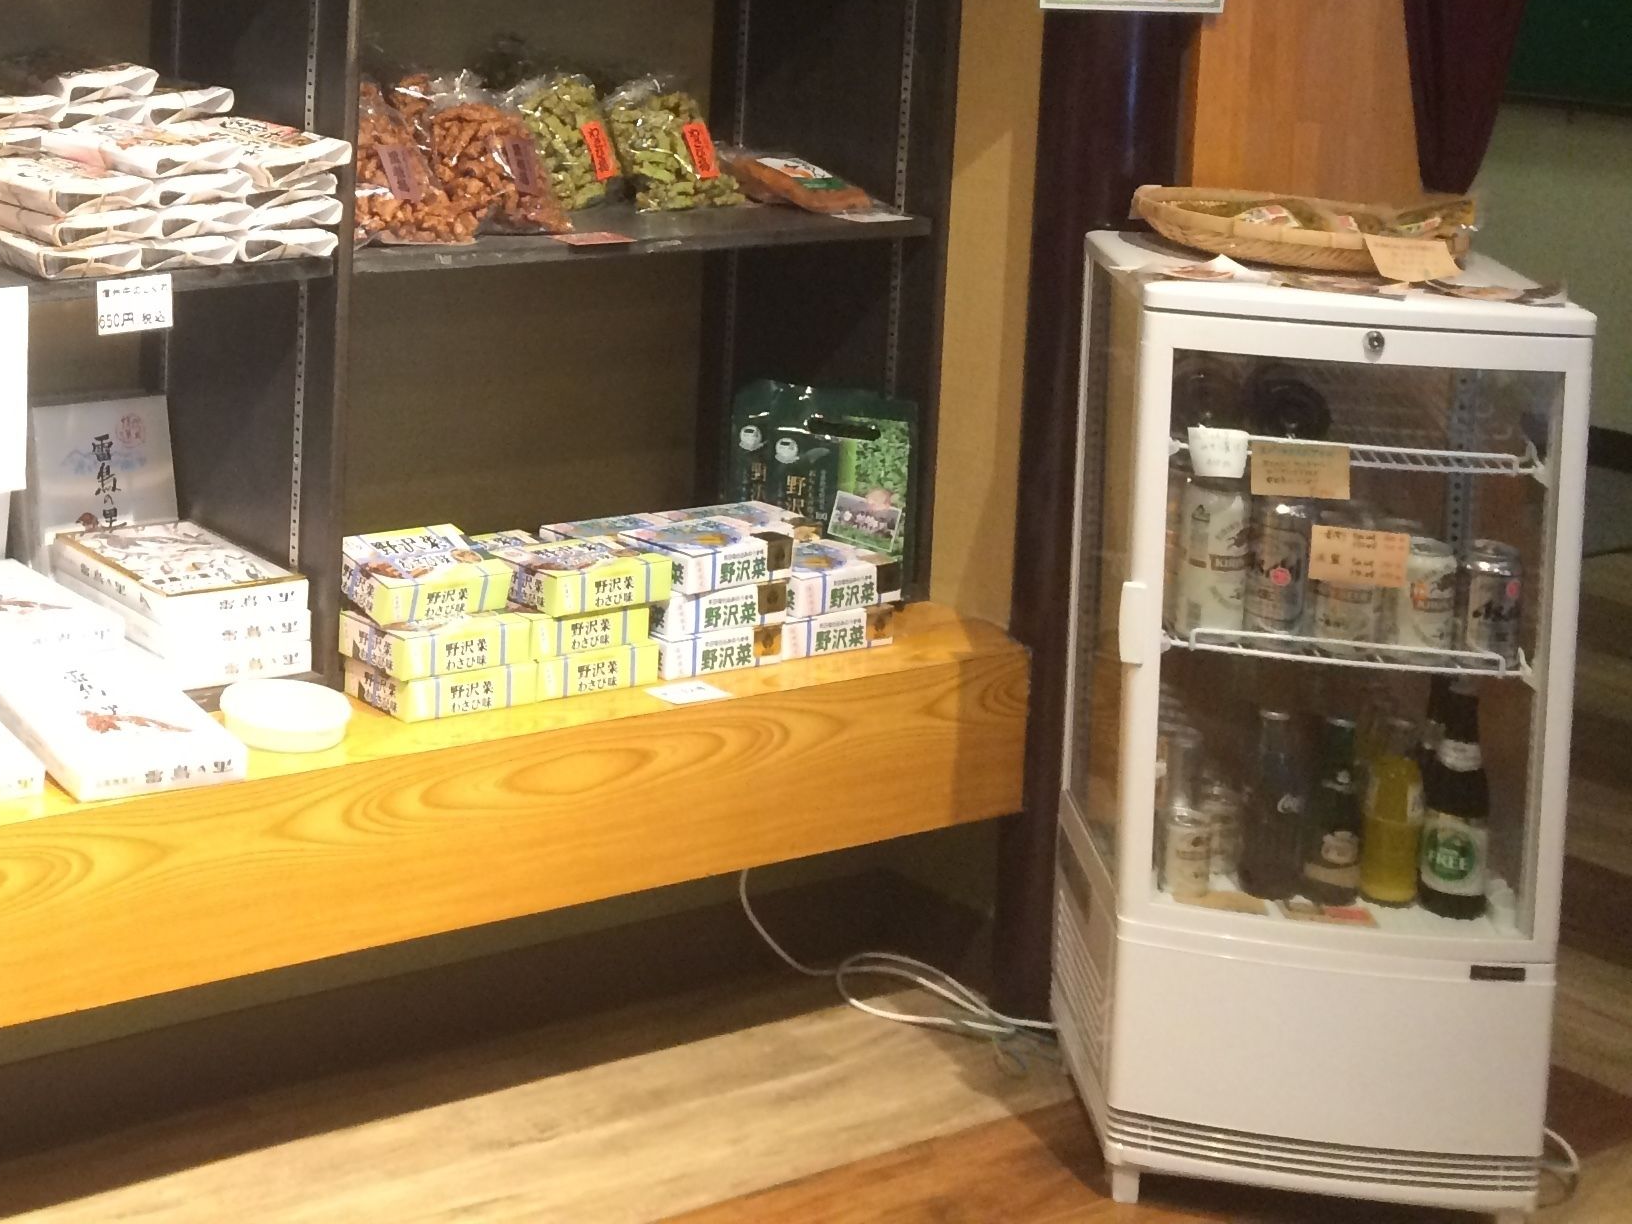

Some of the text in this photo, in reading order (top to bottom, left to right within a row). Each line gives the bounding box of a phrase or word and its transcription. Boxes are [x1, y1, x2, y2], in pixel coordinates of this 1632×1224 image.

[719, 557, 766, 585] 野沢菜
[595, 576, 634, 594] 野沢菜
[830, 581, 875, 608] 野沢菜
[427, 588, 468, 605] 野沢菜
[704, 602, 757, 628] 野沢菜
[571, 618, 611, 636] 野沢菜
[445, 638, 487, 657] 野沢菜
[814, 625, 865, 652] 野沢菜
[701, 643, 752, 671] 野沢菜
[578, 661, 617, 679] 野沢菜
[451, 681, 493, 699] 野沢菜
